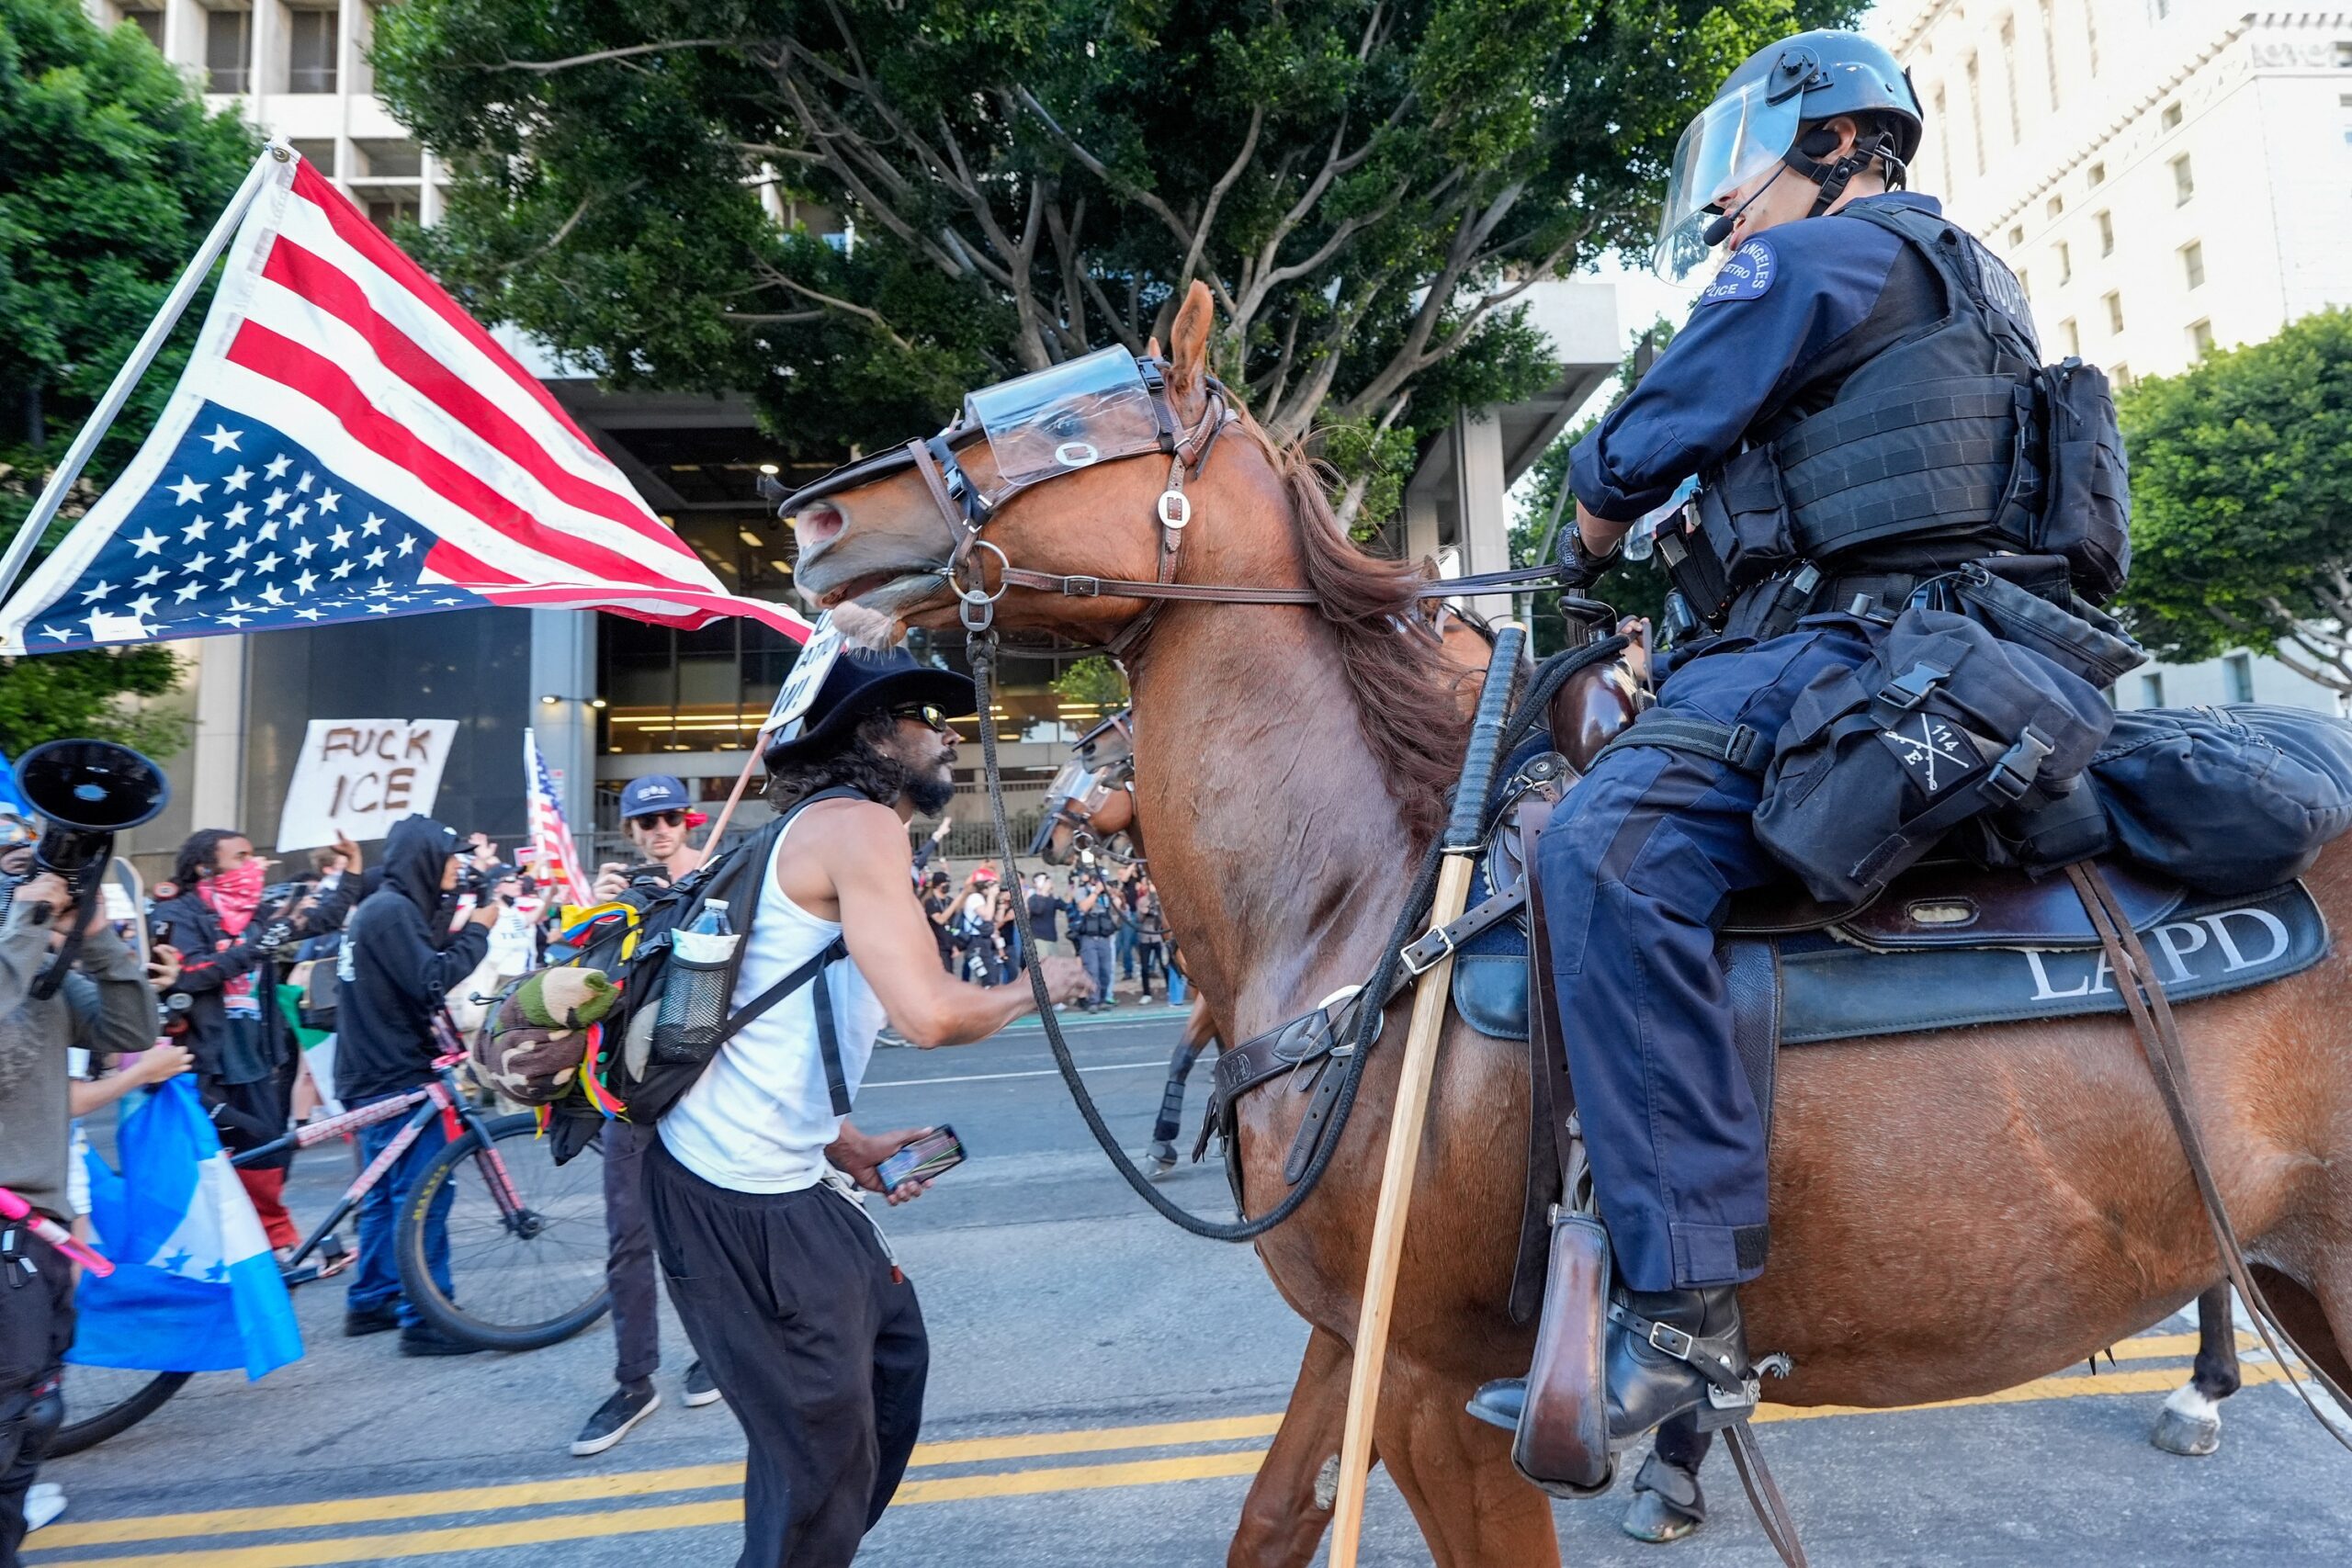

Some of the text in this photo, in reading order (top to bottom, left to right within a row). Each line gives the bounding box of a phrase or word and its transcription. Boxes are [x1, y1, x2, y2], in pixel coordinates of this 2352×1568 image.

[1738, 243, 1770, 289] ANGELES
[1705, 282, 1738, 298] OLICE
[322, 726, 432, 762] FUCK
[1931, 724, 1960, 751] 114
[1904, 750, 1924, 766] E
[328, 767, 415, 818] ICE
[2025, 908, 2290, 1001] LAPD
